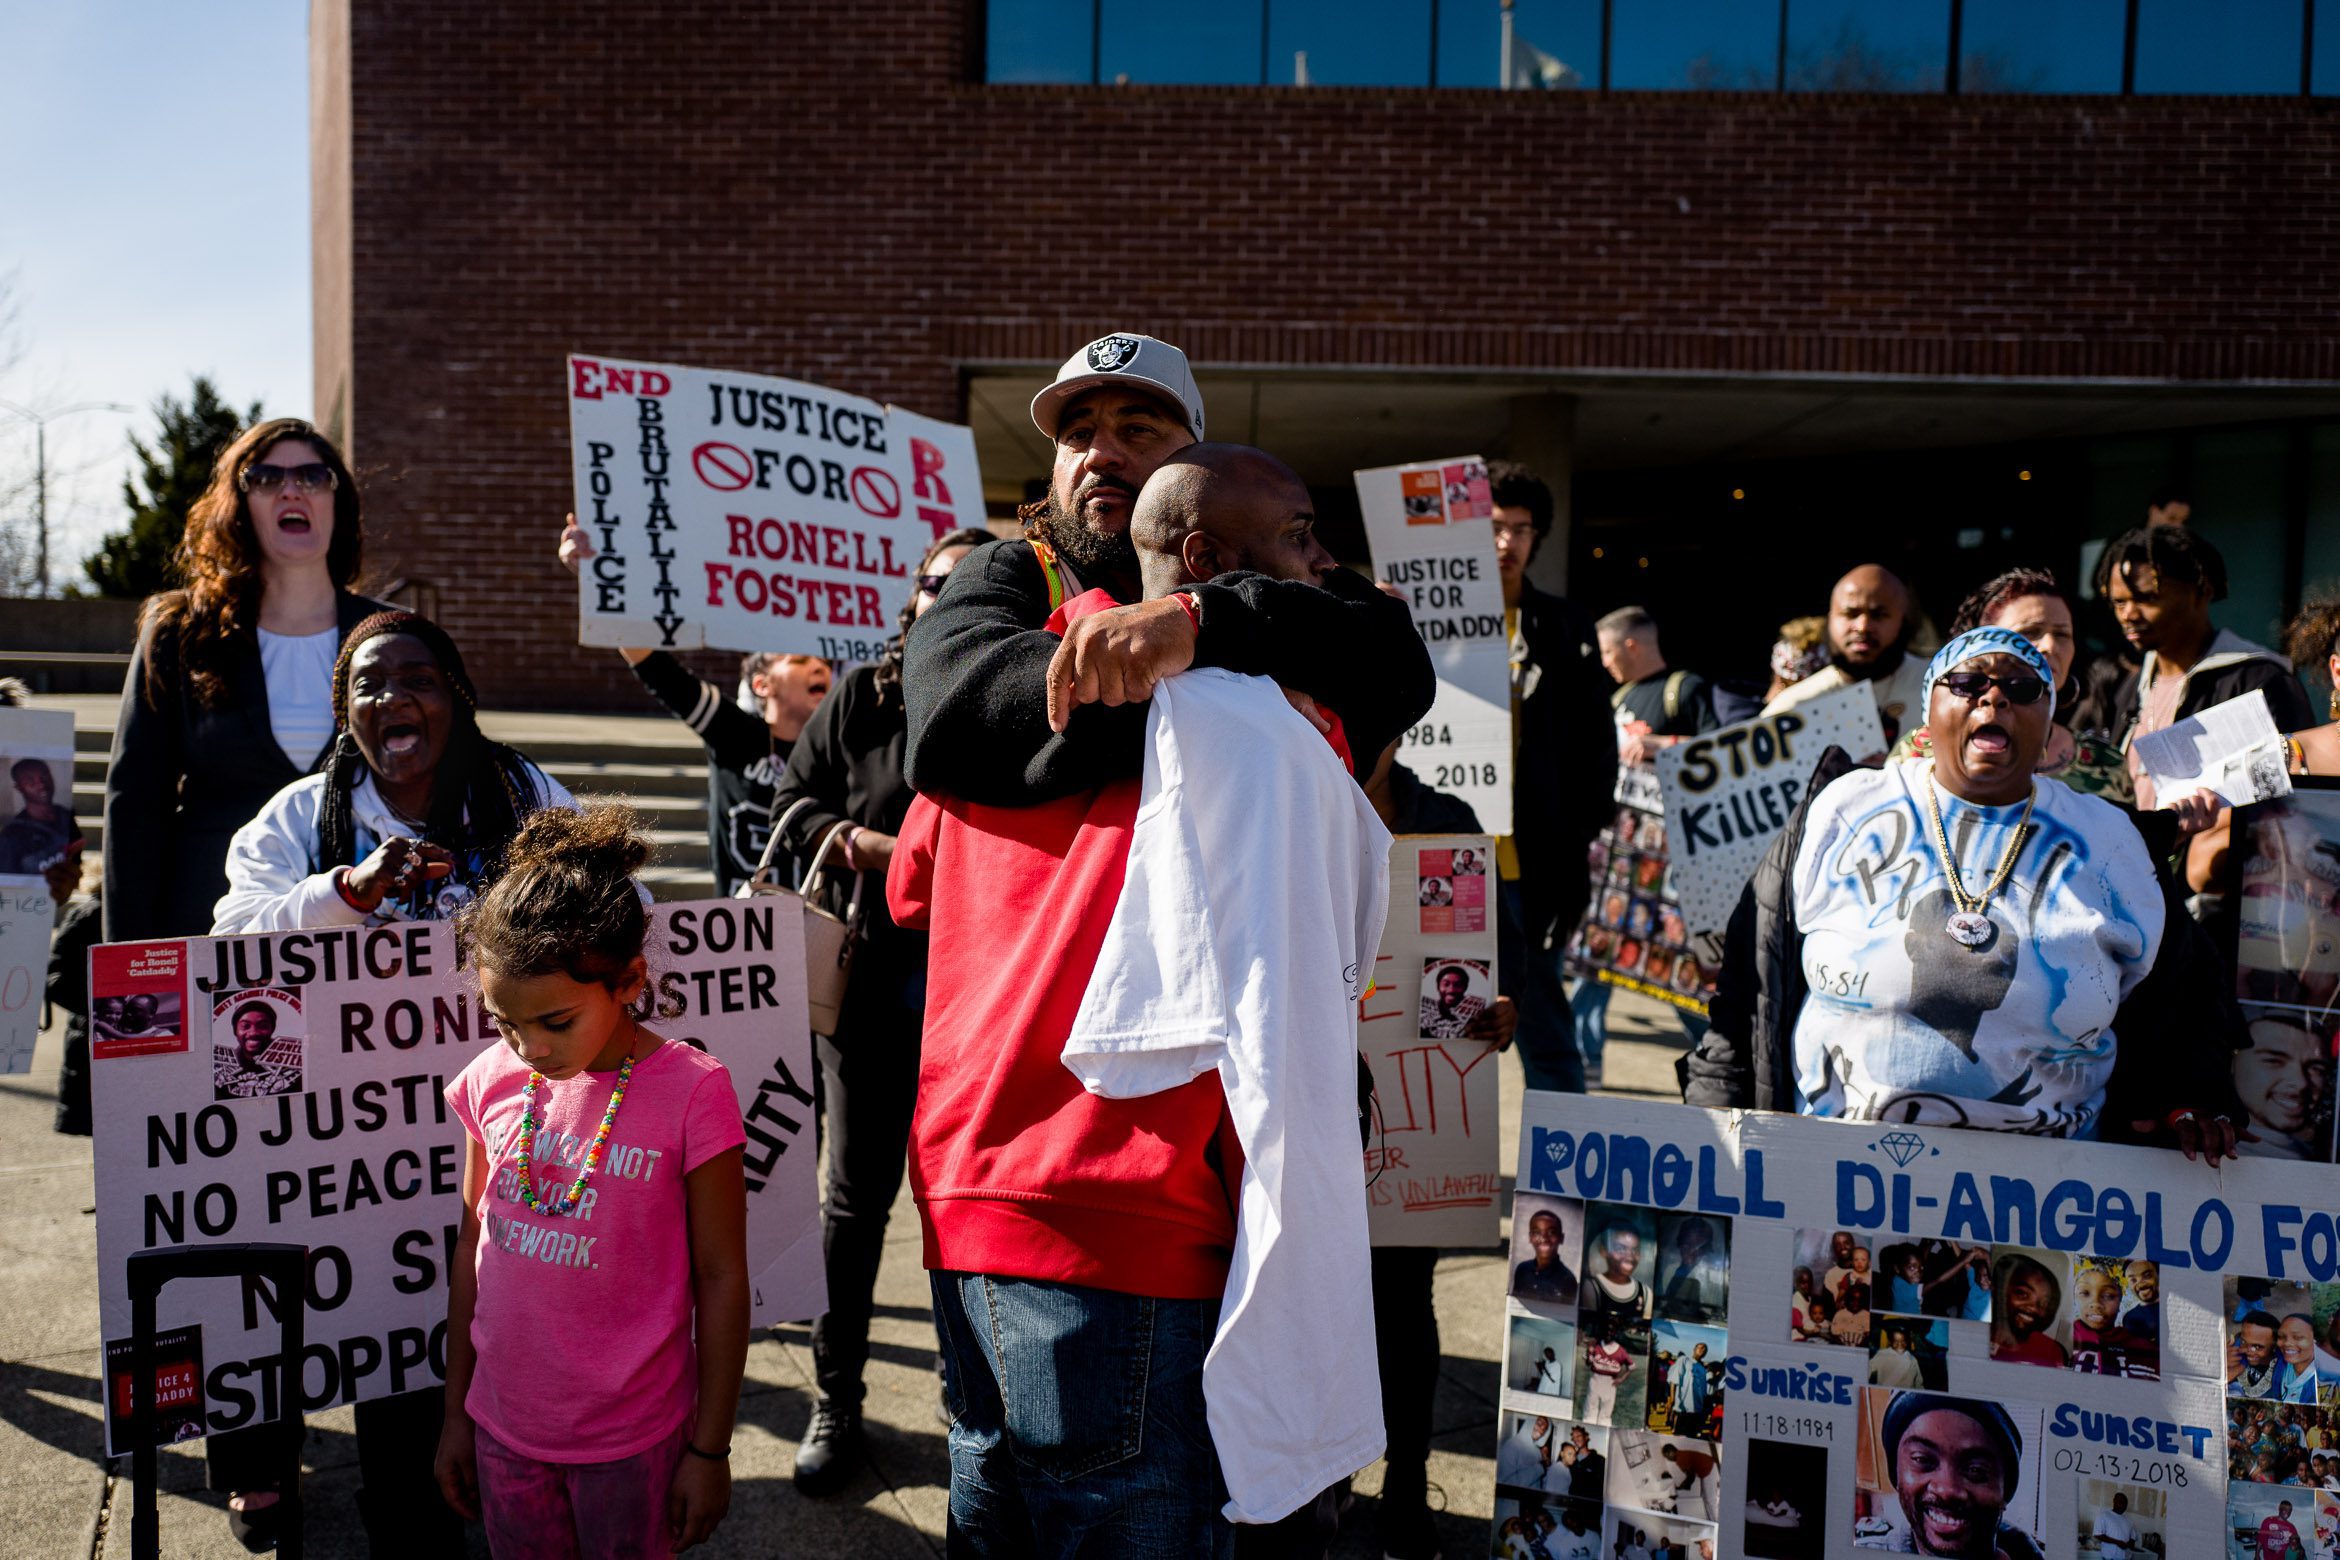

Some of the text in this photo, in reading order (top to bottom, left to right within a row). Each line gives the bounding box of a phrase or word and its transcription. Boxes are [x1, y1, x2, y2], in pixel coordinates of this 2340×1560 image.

[1092, 339, 1134, 349] RAIDERS
[571, 359, 671, 400] END
[709, 383, 887, 454] JUSTICE
[753, 447, 849, 502] FOR
[587, 442, 626, 613] POLICE
[637, 398, 685, 647] BRUTALITY
[726, 514, 907, 578] RONELL
[704, 563, 885, 628] FOSTER
[1382, 558, 1480, 585] JUSTICE
[1414, 585, 1464, 609] FOR
[818, 637, 897, 663] 11-18-8
[1417, 613, 1505, 642] TDADDY
[1436, 763, 1498, 788] 2018
[1679, 711, 1805, 794] STOP
[1680, 779, 1802, 855] KILLER
[145, 949, 178, 957] Justice
[669, 906, 774, 955] SON
[147, 957, 178, 967] Ronell
[196, 928, 432, 993] JUSTICE
[626, 964, 780, 1022] OSTER
[341, 994, 503, 1053] RONE
[147, 1105, 237, 1168] NO
[259, 1074, 447, 1146] JUSTI
[743, 1055, 815, 1193] LITY
[605, 1142, 662, 1182] NOT
[1365, 1146, 1409, 1171] EIR
[144, 1145, 457, 1247] NO PEACE
[537, 1177, 598, 1221] YOR
[1401, 1173, 1501, 1205] UNLAWFUL
[2260, 1204, 2340, 1283] FO
[241, 1245, 352, 1331] NO
[1725, 1355, 1855, 1406] SUNRISE
[2048, 1402, 2213, 1460] SUNSET
